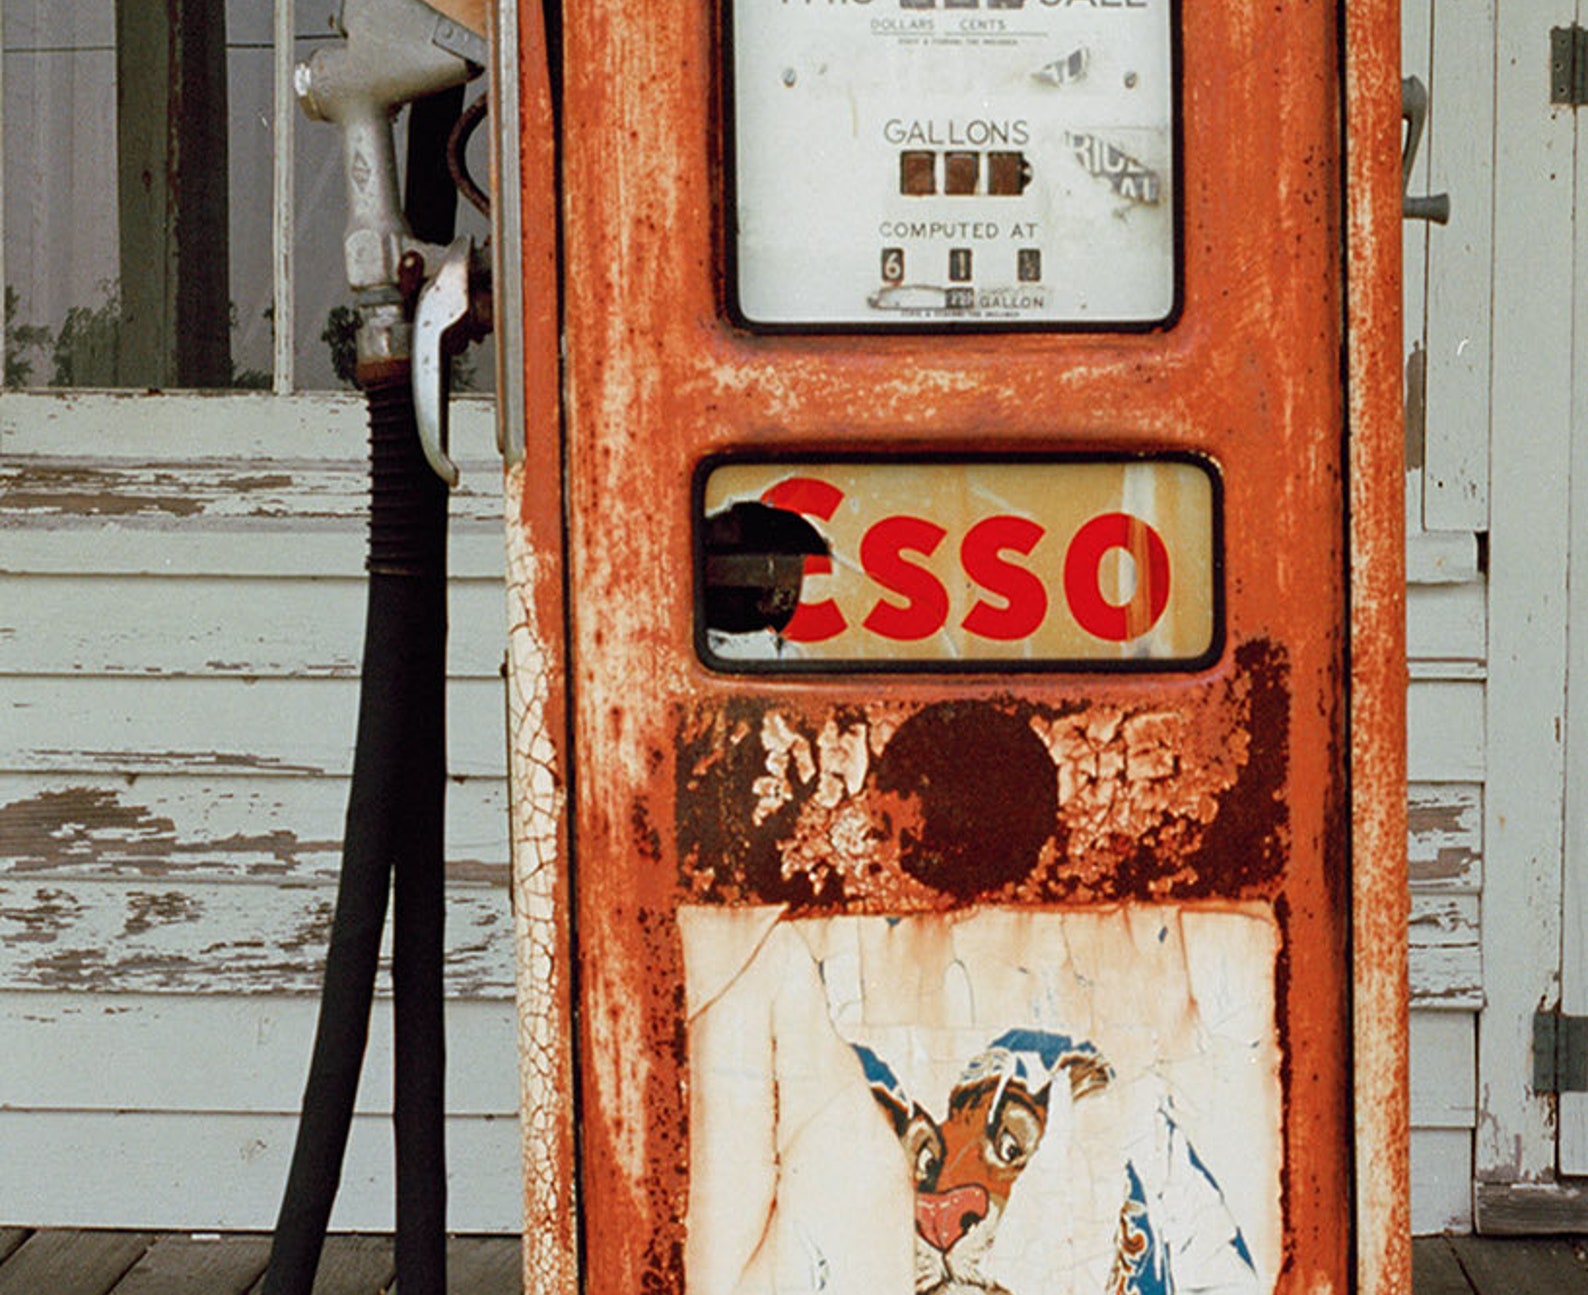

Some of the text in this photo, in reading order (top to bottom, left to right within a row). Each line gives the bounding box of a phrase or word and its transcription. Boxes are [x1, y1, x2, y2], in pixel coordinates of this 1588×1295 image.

[870, 19, 1007, 31] DOLLARS CENTS
[884, 119, 1030, 146] GALLONS
[879, 222, 1039, 239] COMPUTED AT
[884, 251, 902, 279] 6
[979, 295, 1045, 309] GALLON
